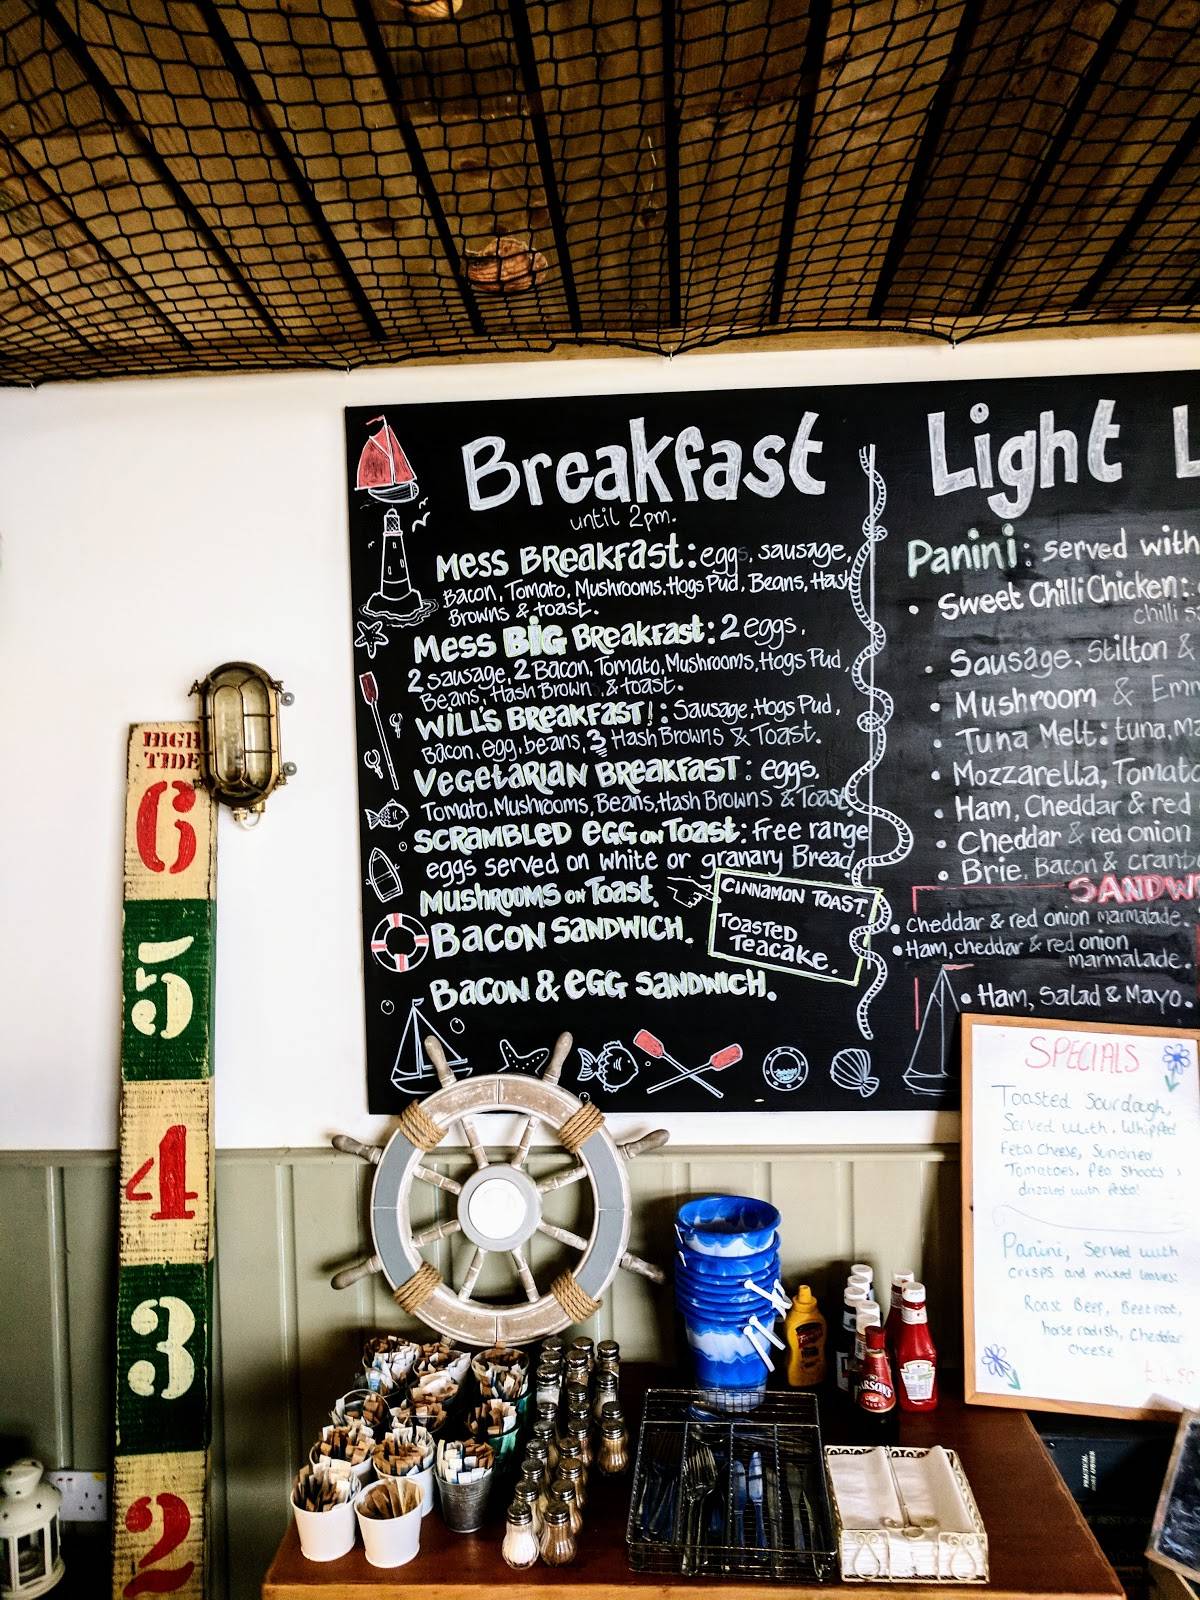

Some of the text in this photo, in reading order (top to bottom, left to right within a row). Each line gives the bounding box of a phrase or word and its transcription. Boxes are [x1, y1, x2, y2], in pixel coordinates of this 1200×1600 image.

[460, 411, 827, 511] Breakfast
[927, 399, 1123, 519] Light
[569, 507, 620, 531] until
[758, 542, 851, 568] sausage,
[1042, 527, 1128, 562] served
[1140, 524, 1200, 556] with
[748, 572, 808, 594] Beans,
[449, 599, 600, 628] Browns & toast.
[937, 581, 1025, 621] Sweet
[1028, 577, 1084, 609] Chilli
[1133, 602, 1178, 624] chilli
[720, 613, 740, 641] 2
[949, 633, 1196, 679] Sausage, Stilton &
[407, 668, 424, 693] 2
[514, 658, 531, 680] 2
[758, 651, 806, 676] Hogs
[490, 682, 535, 704] Hash
[606, 679, 618, 696] &
[619, 676, 684, 695] toast.
[955, 676, 1134, 719] Mushroom &
[753, 697, 796, 723] Hogs
[143, 731, 200, 748] HIGH
[586, 728, 607, 754] 3
[611, 728, 657, 748] Hash
[658, 726, 724, 747] Browns
[730, 727, 751, 747] &
[750, 719, 822, 746] Toast.
[955, 727, 1029, 755] Tuna
[1039, 720, 1108, 749] Melt:
[144, 753, 200, 770] TIDE
[953, 759, 1108, 789] Mozzarella,
[657, 791, 701, 812] Hash
[702, 789, 773, 811] Browns
[780, 790, 796, 808] &
[955, 791, 1191, 823] Ham, Cheddar & red
[136, 780, 196, 874] 6
[809, 820, 869, 849] range
[957, 819, 1191, 856] Cheddar & red onion
[426, 858, 477, 888] eggs
[484, 852, 560, 878] served
[566, 853, 590, 872] on
[599, 848, 659, 871] white
[667, 852, 692, 869] or
[700, 850, 783, 879] granary
[1034, 851, 1117, 880] Bacon &
[989, 913, 1005, 930] &
[1008, 908, 1038, 929] red
[1043, 909, 1090, 927] onion
[905, 939, 953, 960] Ham,
[1029, 938, 1042, 953] &
[1046, 936, 1076, 953] red
[1079, 929, 1129, 951] onion
[131, 935, 194, 1039] 5
[535, 969, 562, 1003] &
[977, 982, 1195, 1015] Ham, Salad & Mayo.
[1025, 1036, 1140, 1074] SPECIALS
[991, 1085, 1071, 1109] Toasted
[126, 1125, 198, 1220] 4
[1083, 1241, 1131, 1258] Served
[1139, 1246, 1179, 1258] with
[1064, 1267, 1086, 1279] and
[1024, 1295, 1062, 1312] Roast
[128, 1296, 196, 1399] 3
[123, 1492, 195, 1599] 2
